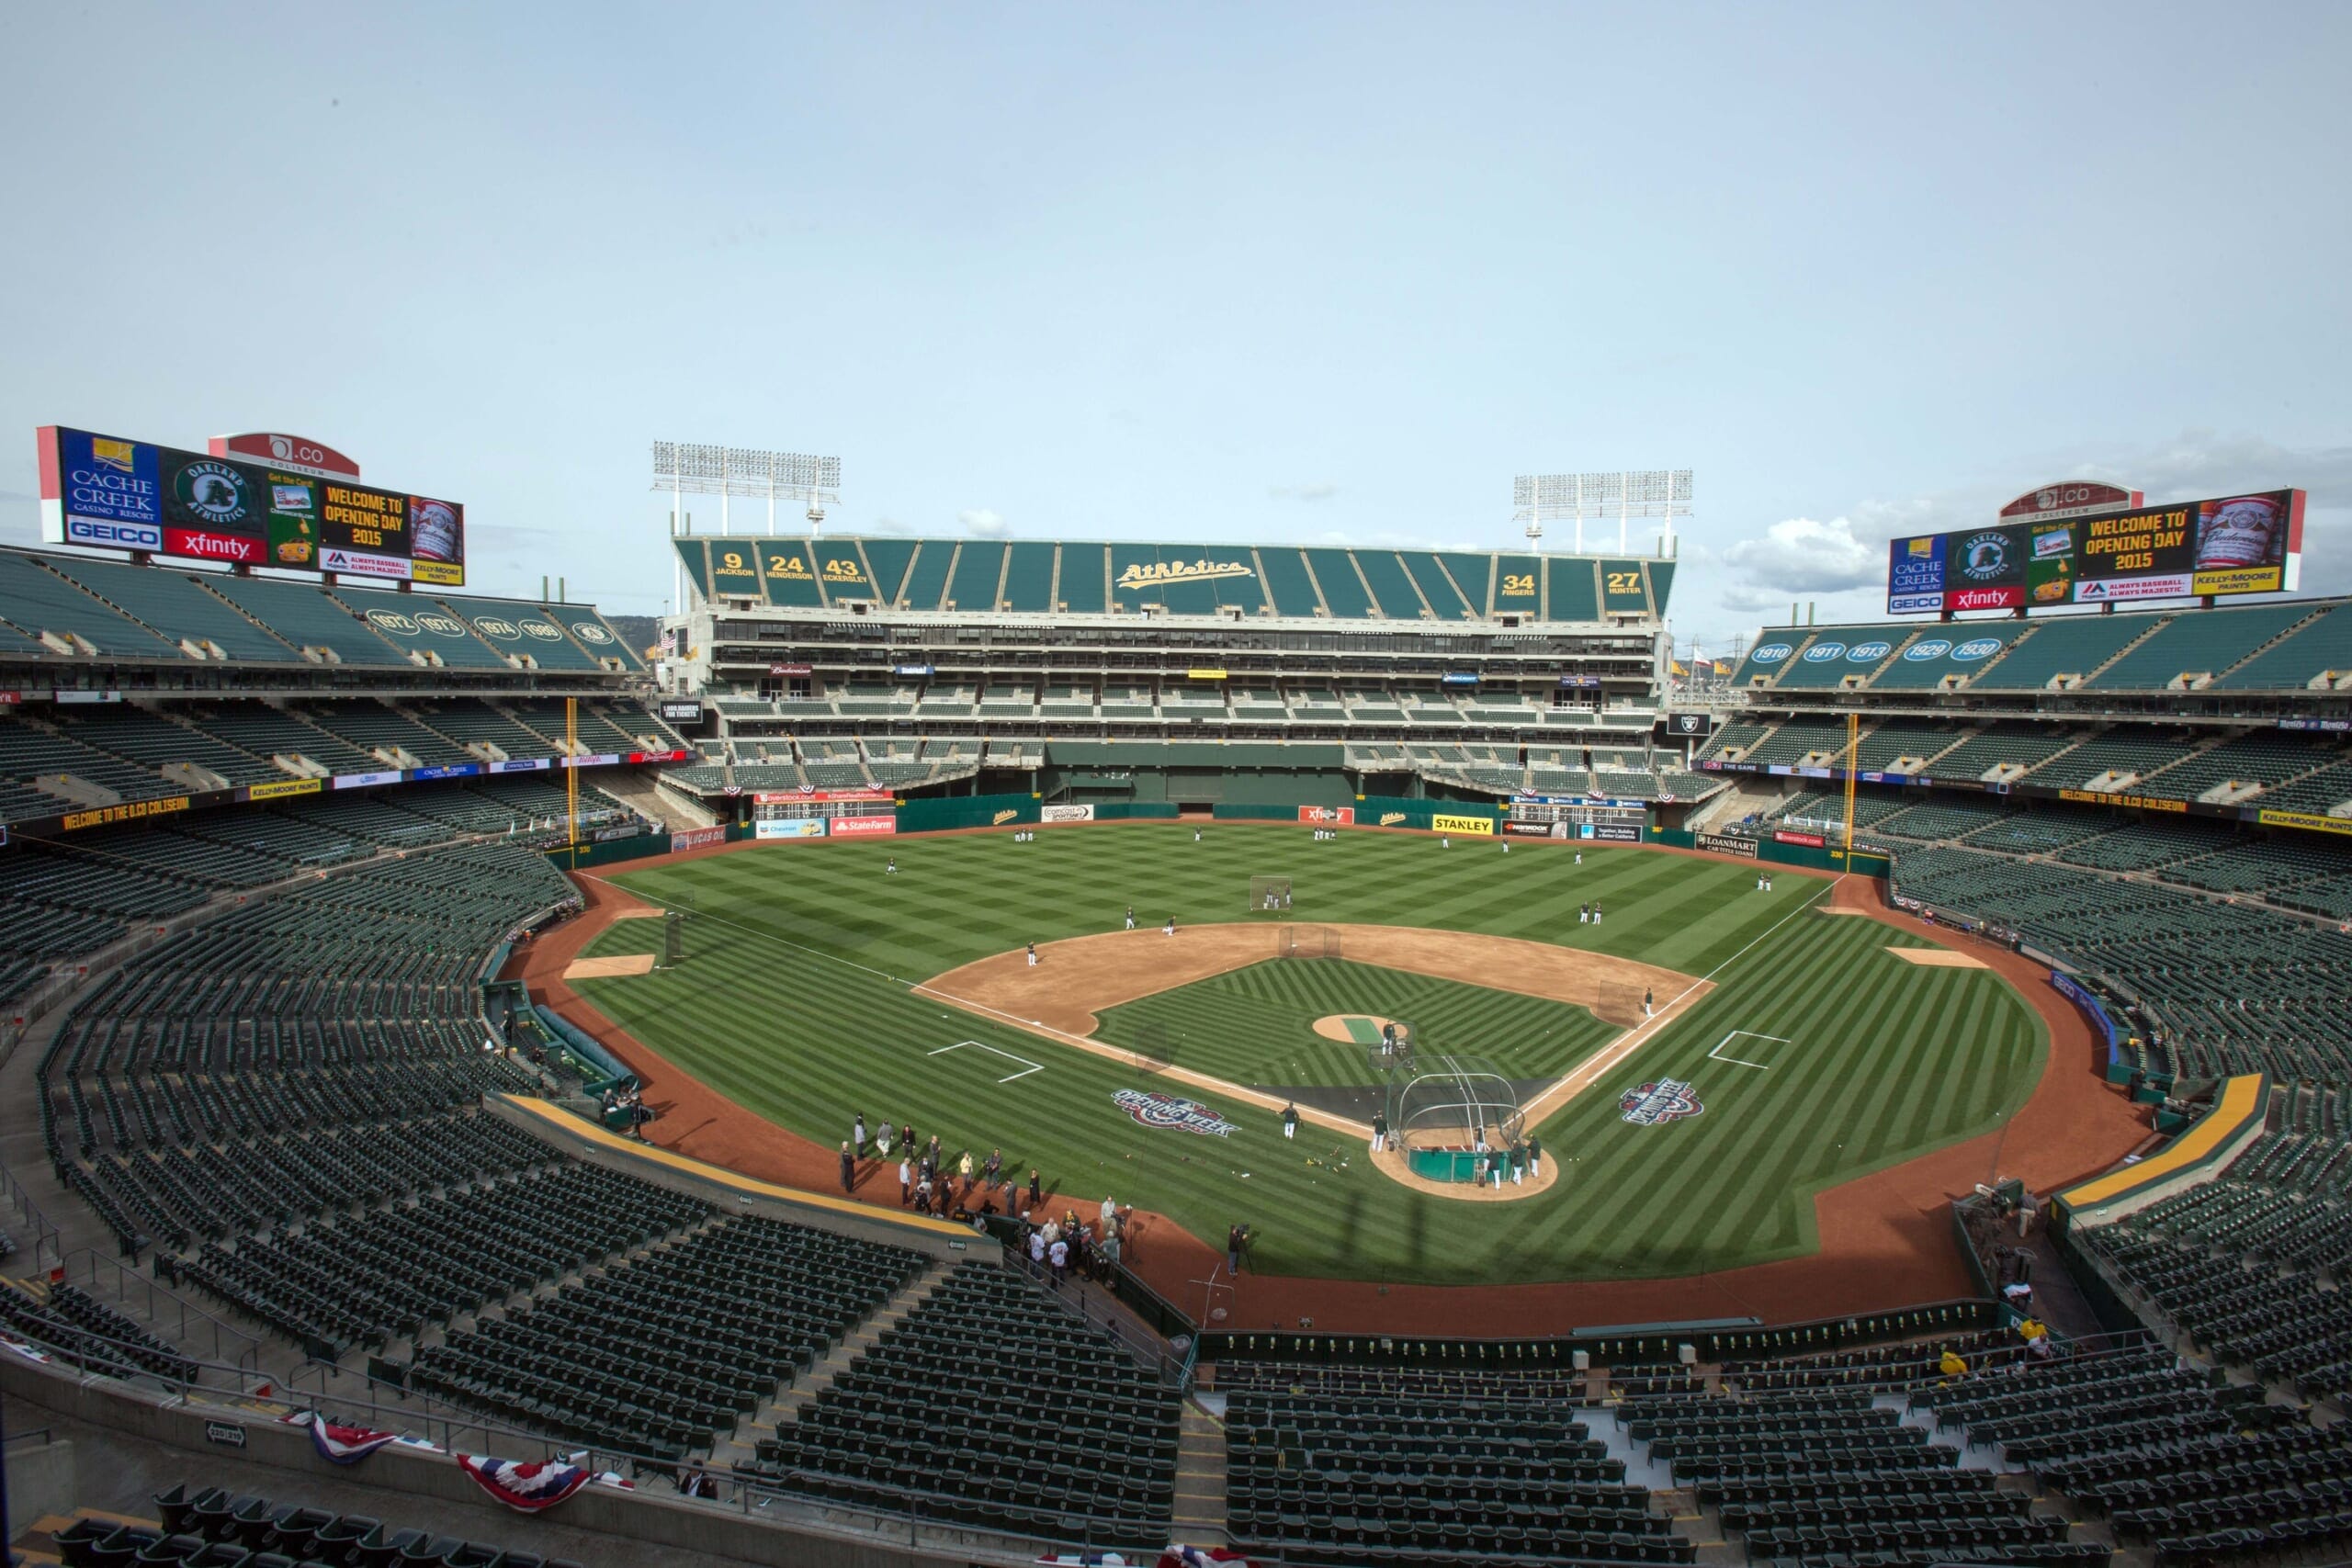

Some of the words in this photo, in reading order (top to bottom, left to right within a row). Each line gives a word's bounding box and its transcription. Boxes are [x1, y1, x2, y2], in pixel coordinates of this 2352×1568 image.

[187, 462, 243, 487] OAKLAND
[270, 460, 324, 476] COLISEUM
[73, 469, 153, 495] CACHE
[73, 488, 153, 512] CREEK
[326, 487, 385, 511] WELCOME
[388, 497, 402, 513] TO
[74, 503, 113, 515] CASINO
[119, 509, 155, 521] RESORT
[187, 502, 245, 523] ATHLETICS
[325, 505, 379, 529] OPENING
[381, 515, 403, 532] DAY
[2089, 514, 2162, 537] WELCOME
[2165, 511, 2187, 527] TO
[71, 521, 159, 545] GEICO
[352, 528, 382, 546] 2015
[185, 534, 250, 558] xfinity
[1966, 535, 2008, 550] OAKLAND
[2086, 535, 2151, 555] OPENING
[2154, 531, 2186, 548] DAY
[351, 557, 376, 565] ALWAYS
[351, 563, 376, 572] ALWAYS
[724, 553, 742, 569] 9
[769, 556, 804, 572] 24
[826, 559, 858, 576] 43
[1895, 561, 1941, 574] CACHE
[2115, 553, 2154, 570] 2015
[414, 564, 459, 575] KELLY-MOORE
[427, 572, 447, 581] PAINTS
[715, 568, 754, 577] JACKSON
[766, 570, 813, 581] HENDERSON
[1115, 559, 1251, 589] Athletics
[1963, 562, 2009, 580] ATHLETICS
[822, 574, 867, 583] ECKERSLEY
[1503, 574, 1534, 590] 34
[1608, 572, 1639, 588] 27
[1894, 574, 1940, 587] CREEK
[2197, 571, 2274, 585] KELLY-MOORE
[1609, 586, 1641, 594] HUNTER
[2109, 582, 2140, 591] ALWAYS
[2109, 589, 2140, 597] ALWAYS
[2218, 581, 2250, 591] PAINTS
[1892, 596, 1941, 609] GEICO
[1958, 590, 2008, 608] xfinity
[372, 614, 415, 629] 1972
[419, 617, 460, 632] 1973
[480, 621, 515, 635] 1974
[523, 623, 556, 637] 1989
[1756, 647, 1790, 660] 1910
[1807, 645, 1842, 659] 1911
[1851, 645, 1887, 659] 1913
[1909, 642, 1947, 657] 1929
[1958, 641, 1996, 657] 1930
[771, 665, 812, 675] Budweiser
[579, 756, 602, 764] AVAYA
[252, 784, 298, 796] KELLY-MOORE
[2059, 789, 2097, 802] WELCOME
[2098, 793, 2106, 803] TO
[2108, 794, 2122, 806] THE
[2143, 797, 2187, 812] COLISEUM
[63, 810, 103, 830] WELCOME
[104, 808, 113, 822] TO
[114, 806, 129, 819] THE
[148, 796, 189, 815] COLISEUM
[1308, 809, 1343, 820] xfiy
[2262, 812, 2321, 827] KELLY-MOORE
[1436, 818, 1490, 831] STANLEY
[689, 831, 712, 844] LUCAS
[713, 829, 725, 840] OIL
[579, 846, 591, 854] 330
[1716, 846, 1734, 854] TITLE
[1735, 849, 1753, 858] LOANS
[1830, 851, 1843, 859] 330
[2053, 975, 2075, 998] GEICO
[1116, 1089, 1186, 1118] OPENING
[1186, 1111, 1235, 1136] WEEK
